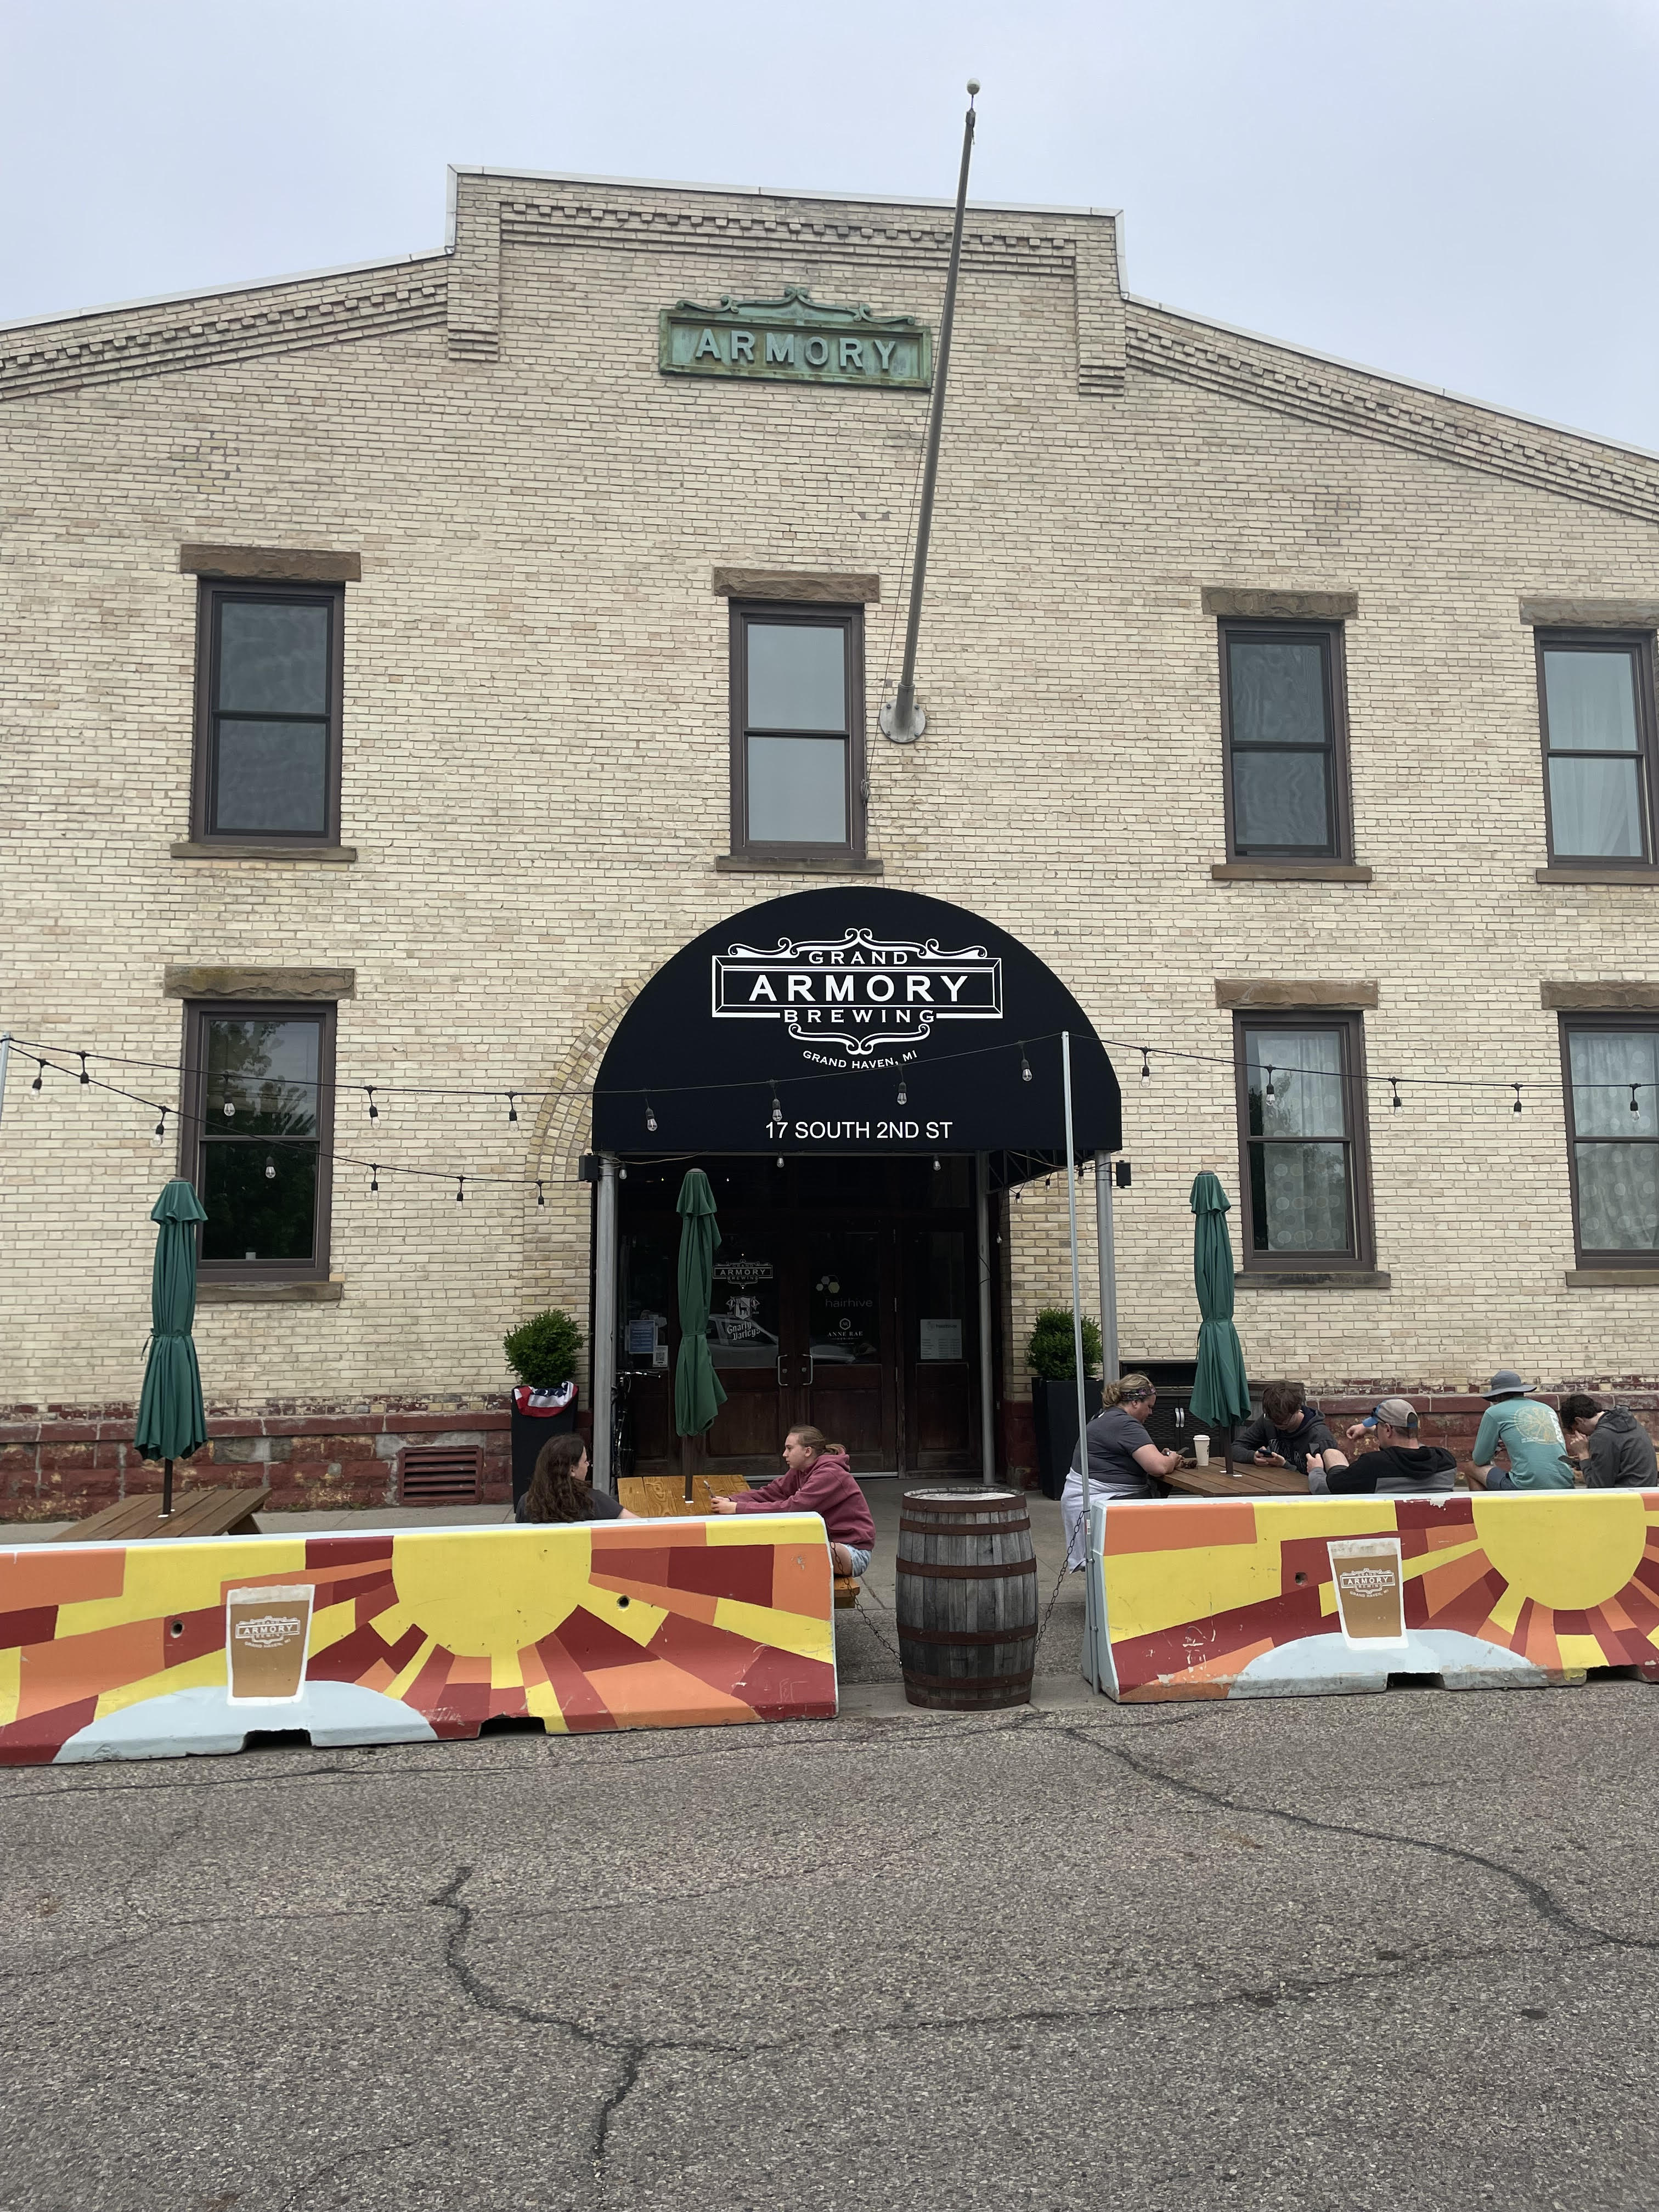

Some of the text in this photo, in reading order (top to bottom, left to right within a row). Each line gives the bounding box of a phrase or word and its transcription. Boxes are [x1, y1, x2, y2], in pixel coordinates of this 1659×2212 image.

[695, 328, 896, 370] ARMORY
[809, 951, 908, 965] GRAND
[748, 974, 968, 1002] ARMORY
[783, 1009, 935, 1023] BREWING
[803, 1049, 918, 1069] GRAND HAVEN, MI
[766, 1121, 953, 1139] 17 SOUTH 2ND ST
[825, 1297, 873, 1307] hairhive
[1347, 1577, 1389, 1585] ARMORY
[244, 1625, 292, 1634] ARMORY
